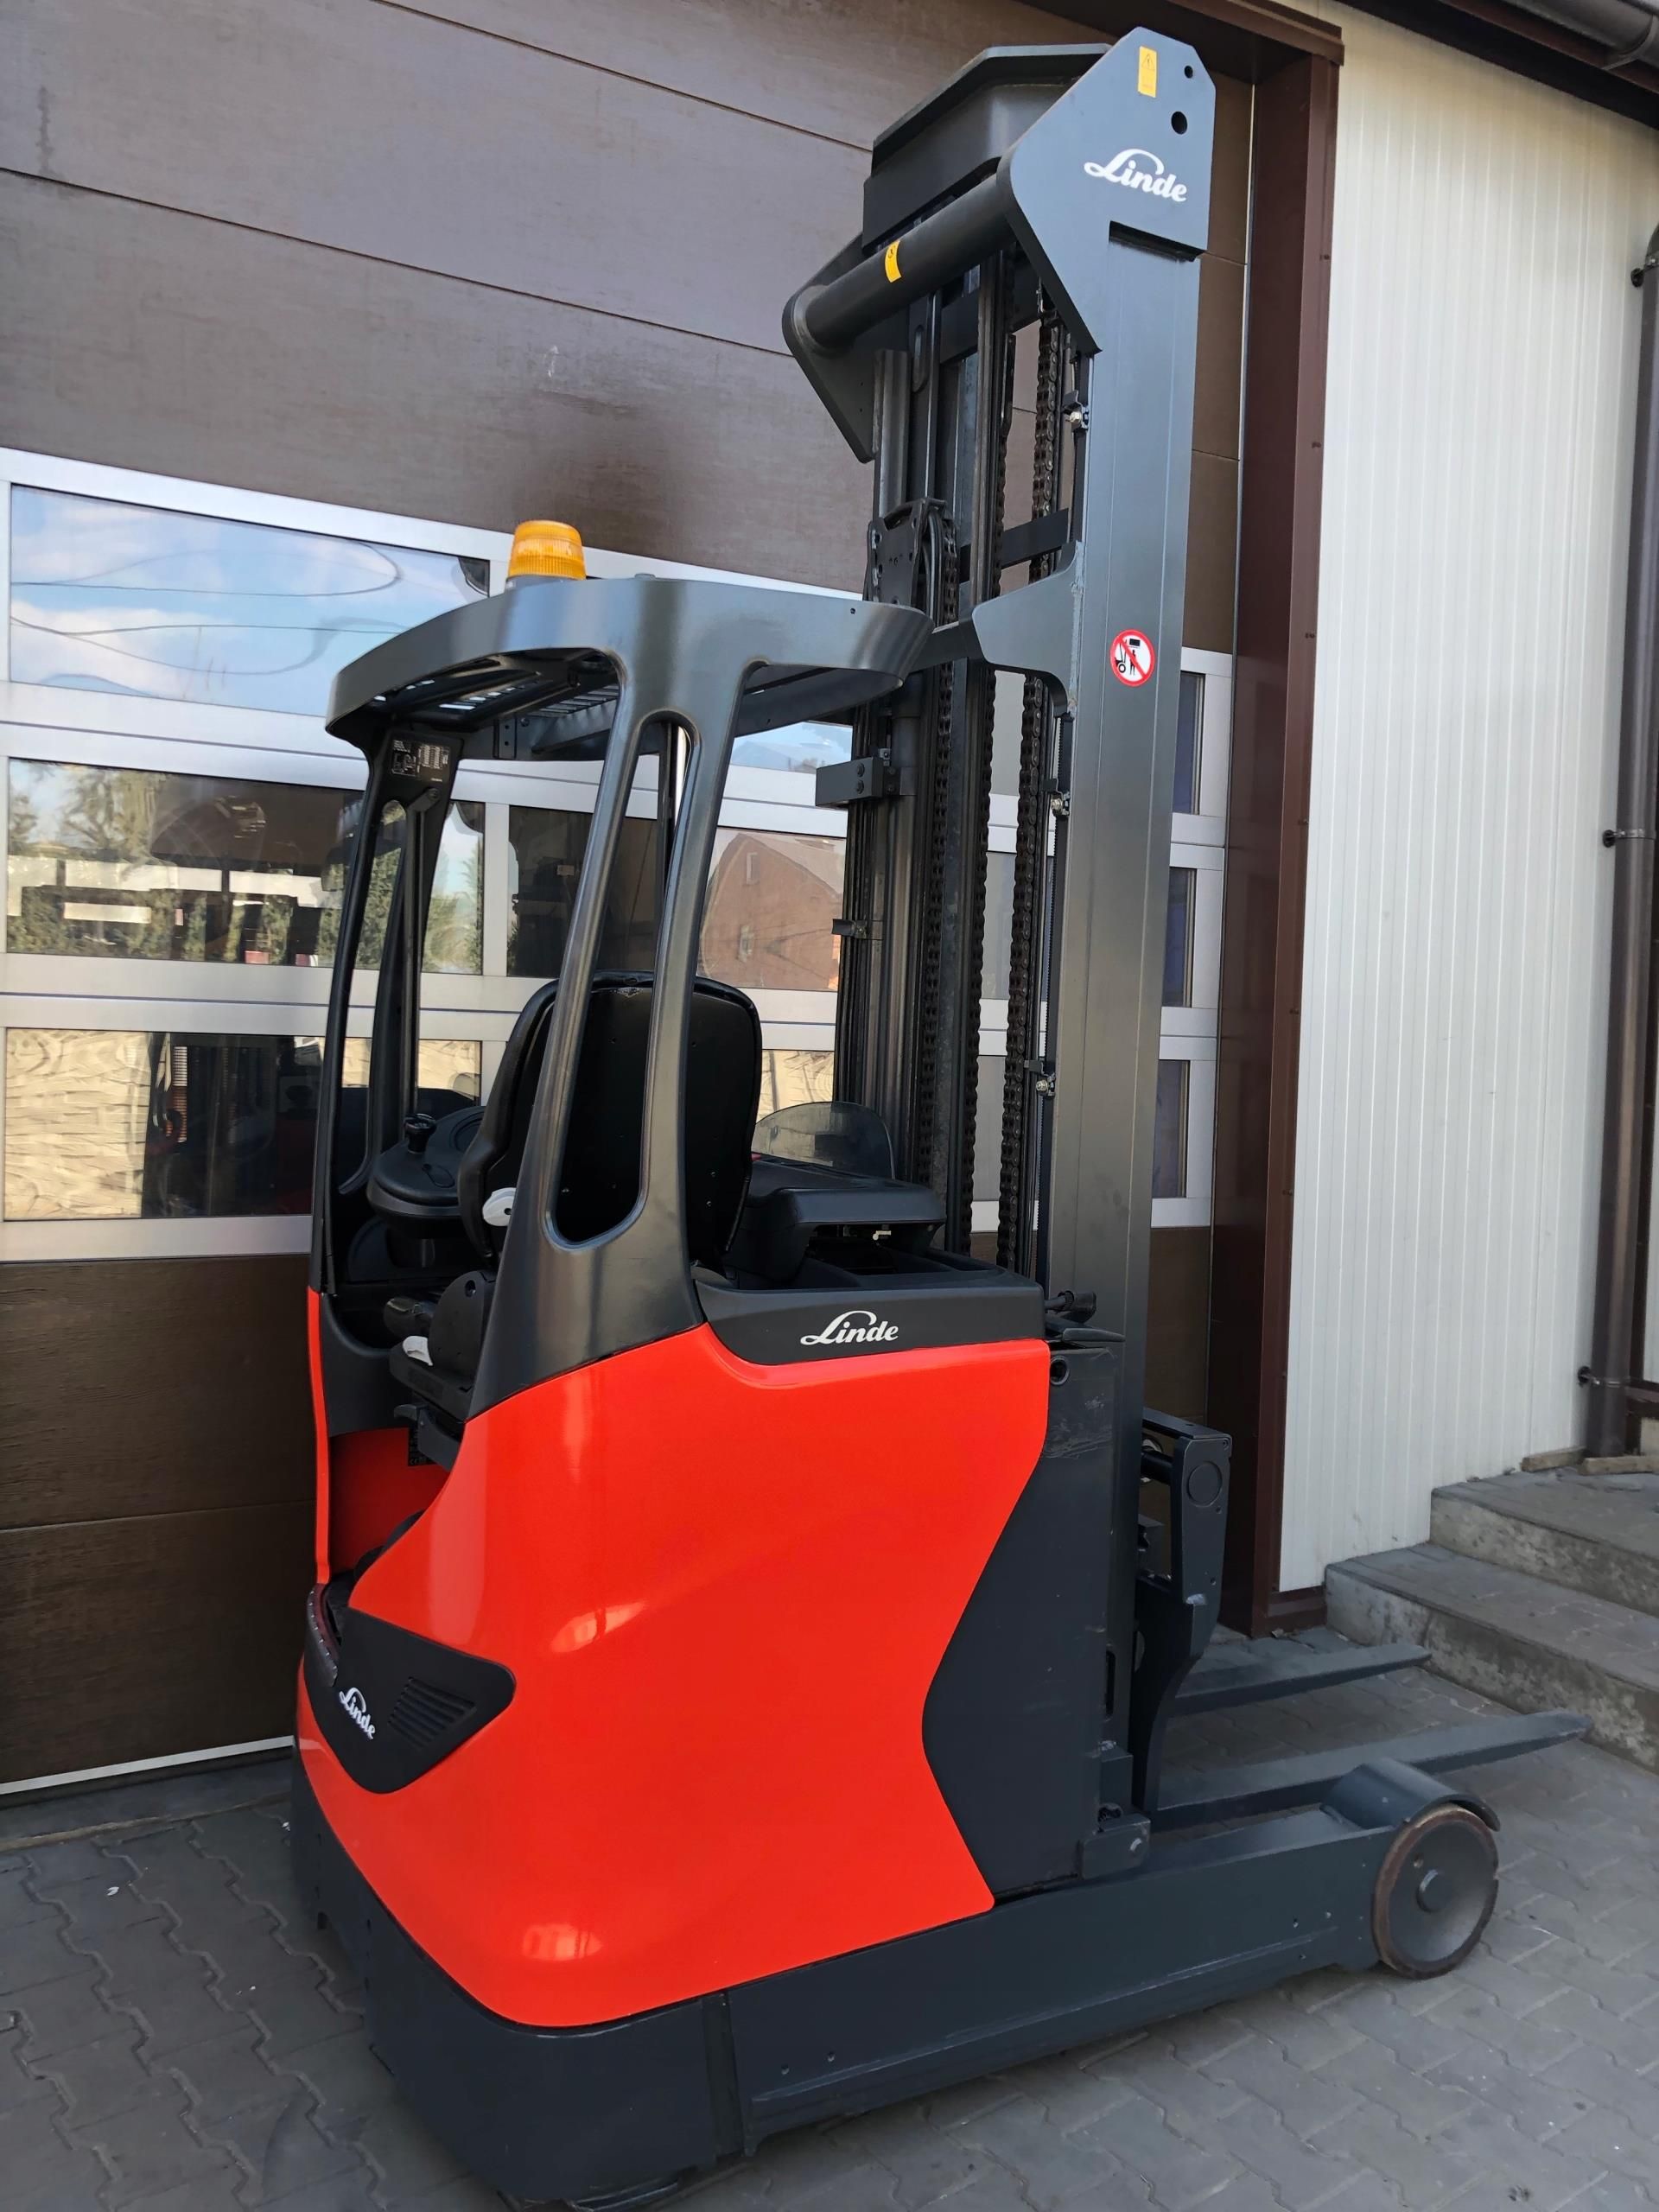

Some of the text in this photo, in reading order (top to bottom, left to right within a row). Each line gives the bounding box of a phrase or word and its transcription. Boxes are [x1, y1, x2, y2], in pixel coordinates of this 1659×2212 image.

[1084, 148, 1187, 202] Linde
[800, 1310, 899, 1345] Linde
[339, 1687, 376, 1739] Linde
